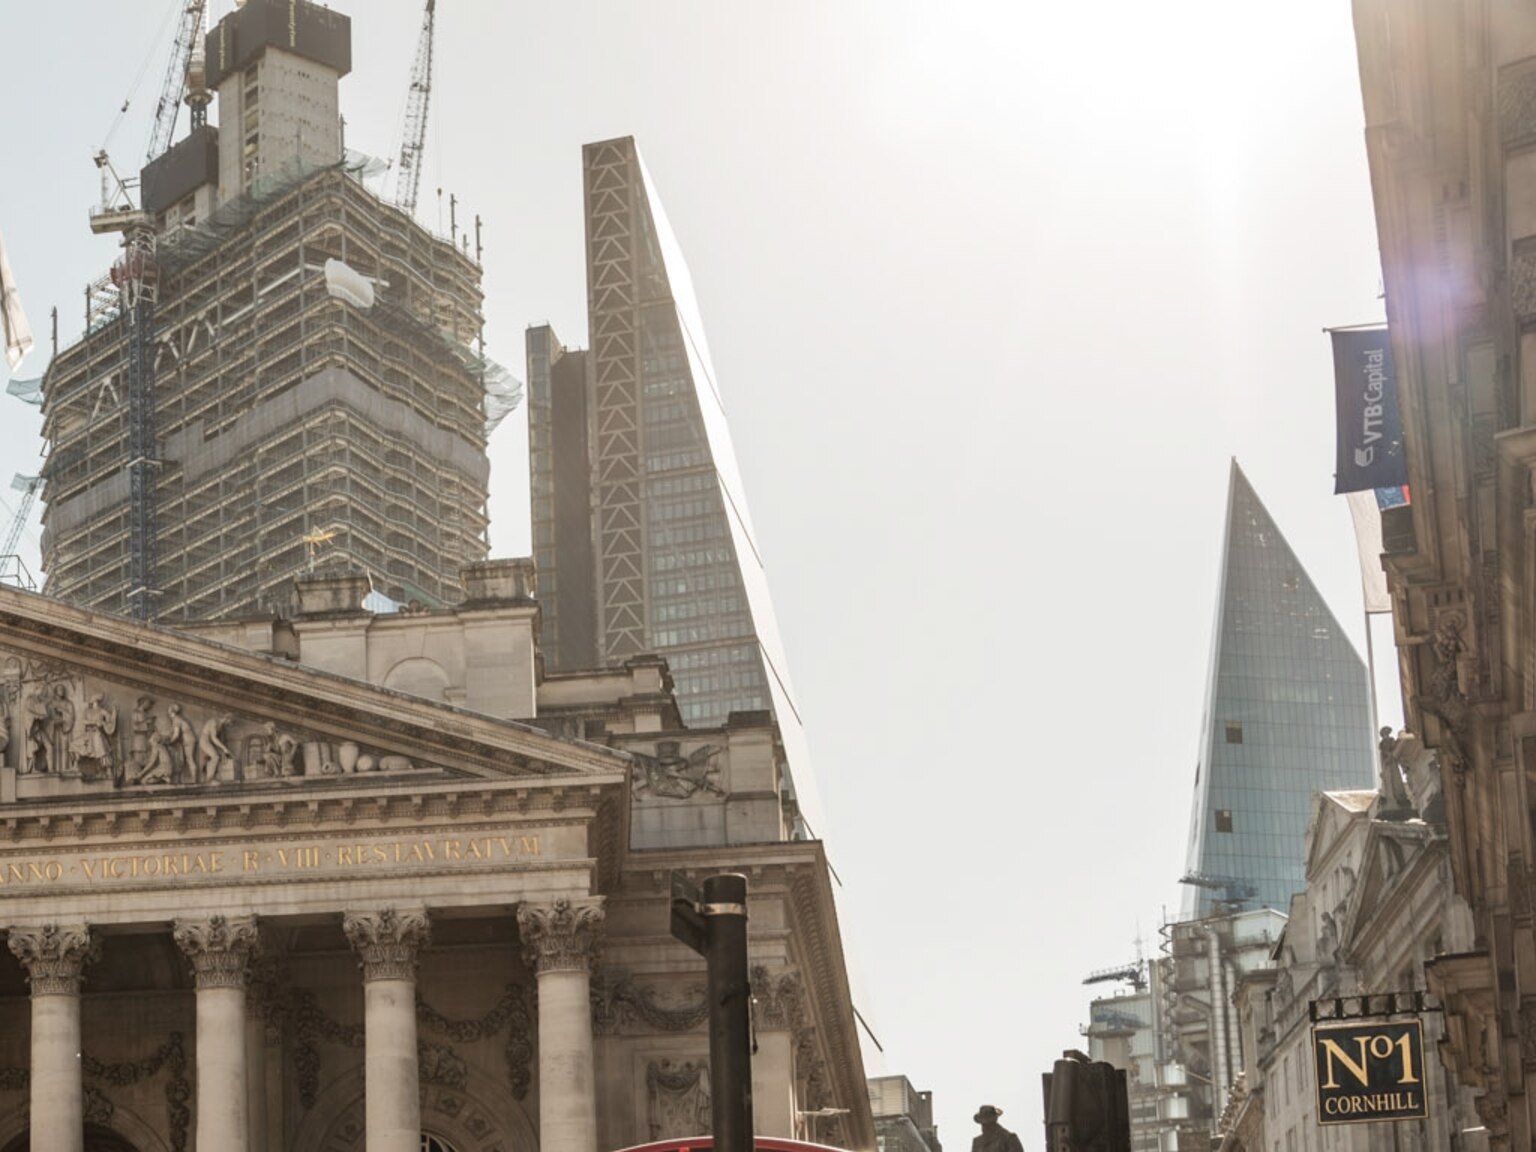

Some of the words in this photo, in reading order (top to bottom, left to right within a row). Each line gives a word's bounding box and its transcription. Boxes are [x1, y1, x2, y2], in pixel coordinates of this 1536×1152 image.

[1363, 348, 1388, 401] Capital
[1363, 403, 1383, 444] VTB
[80, 850, 225, 880] VICTORIAE
[242, 848, 260, 872] R
[278, 845, 320, 869] VIII
[336, 835, 542, 866] RESTAVRATVM
[1325, 1092, 1419, 1115] CORNHILL
